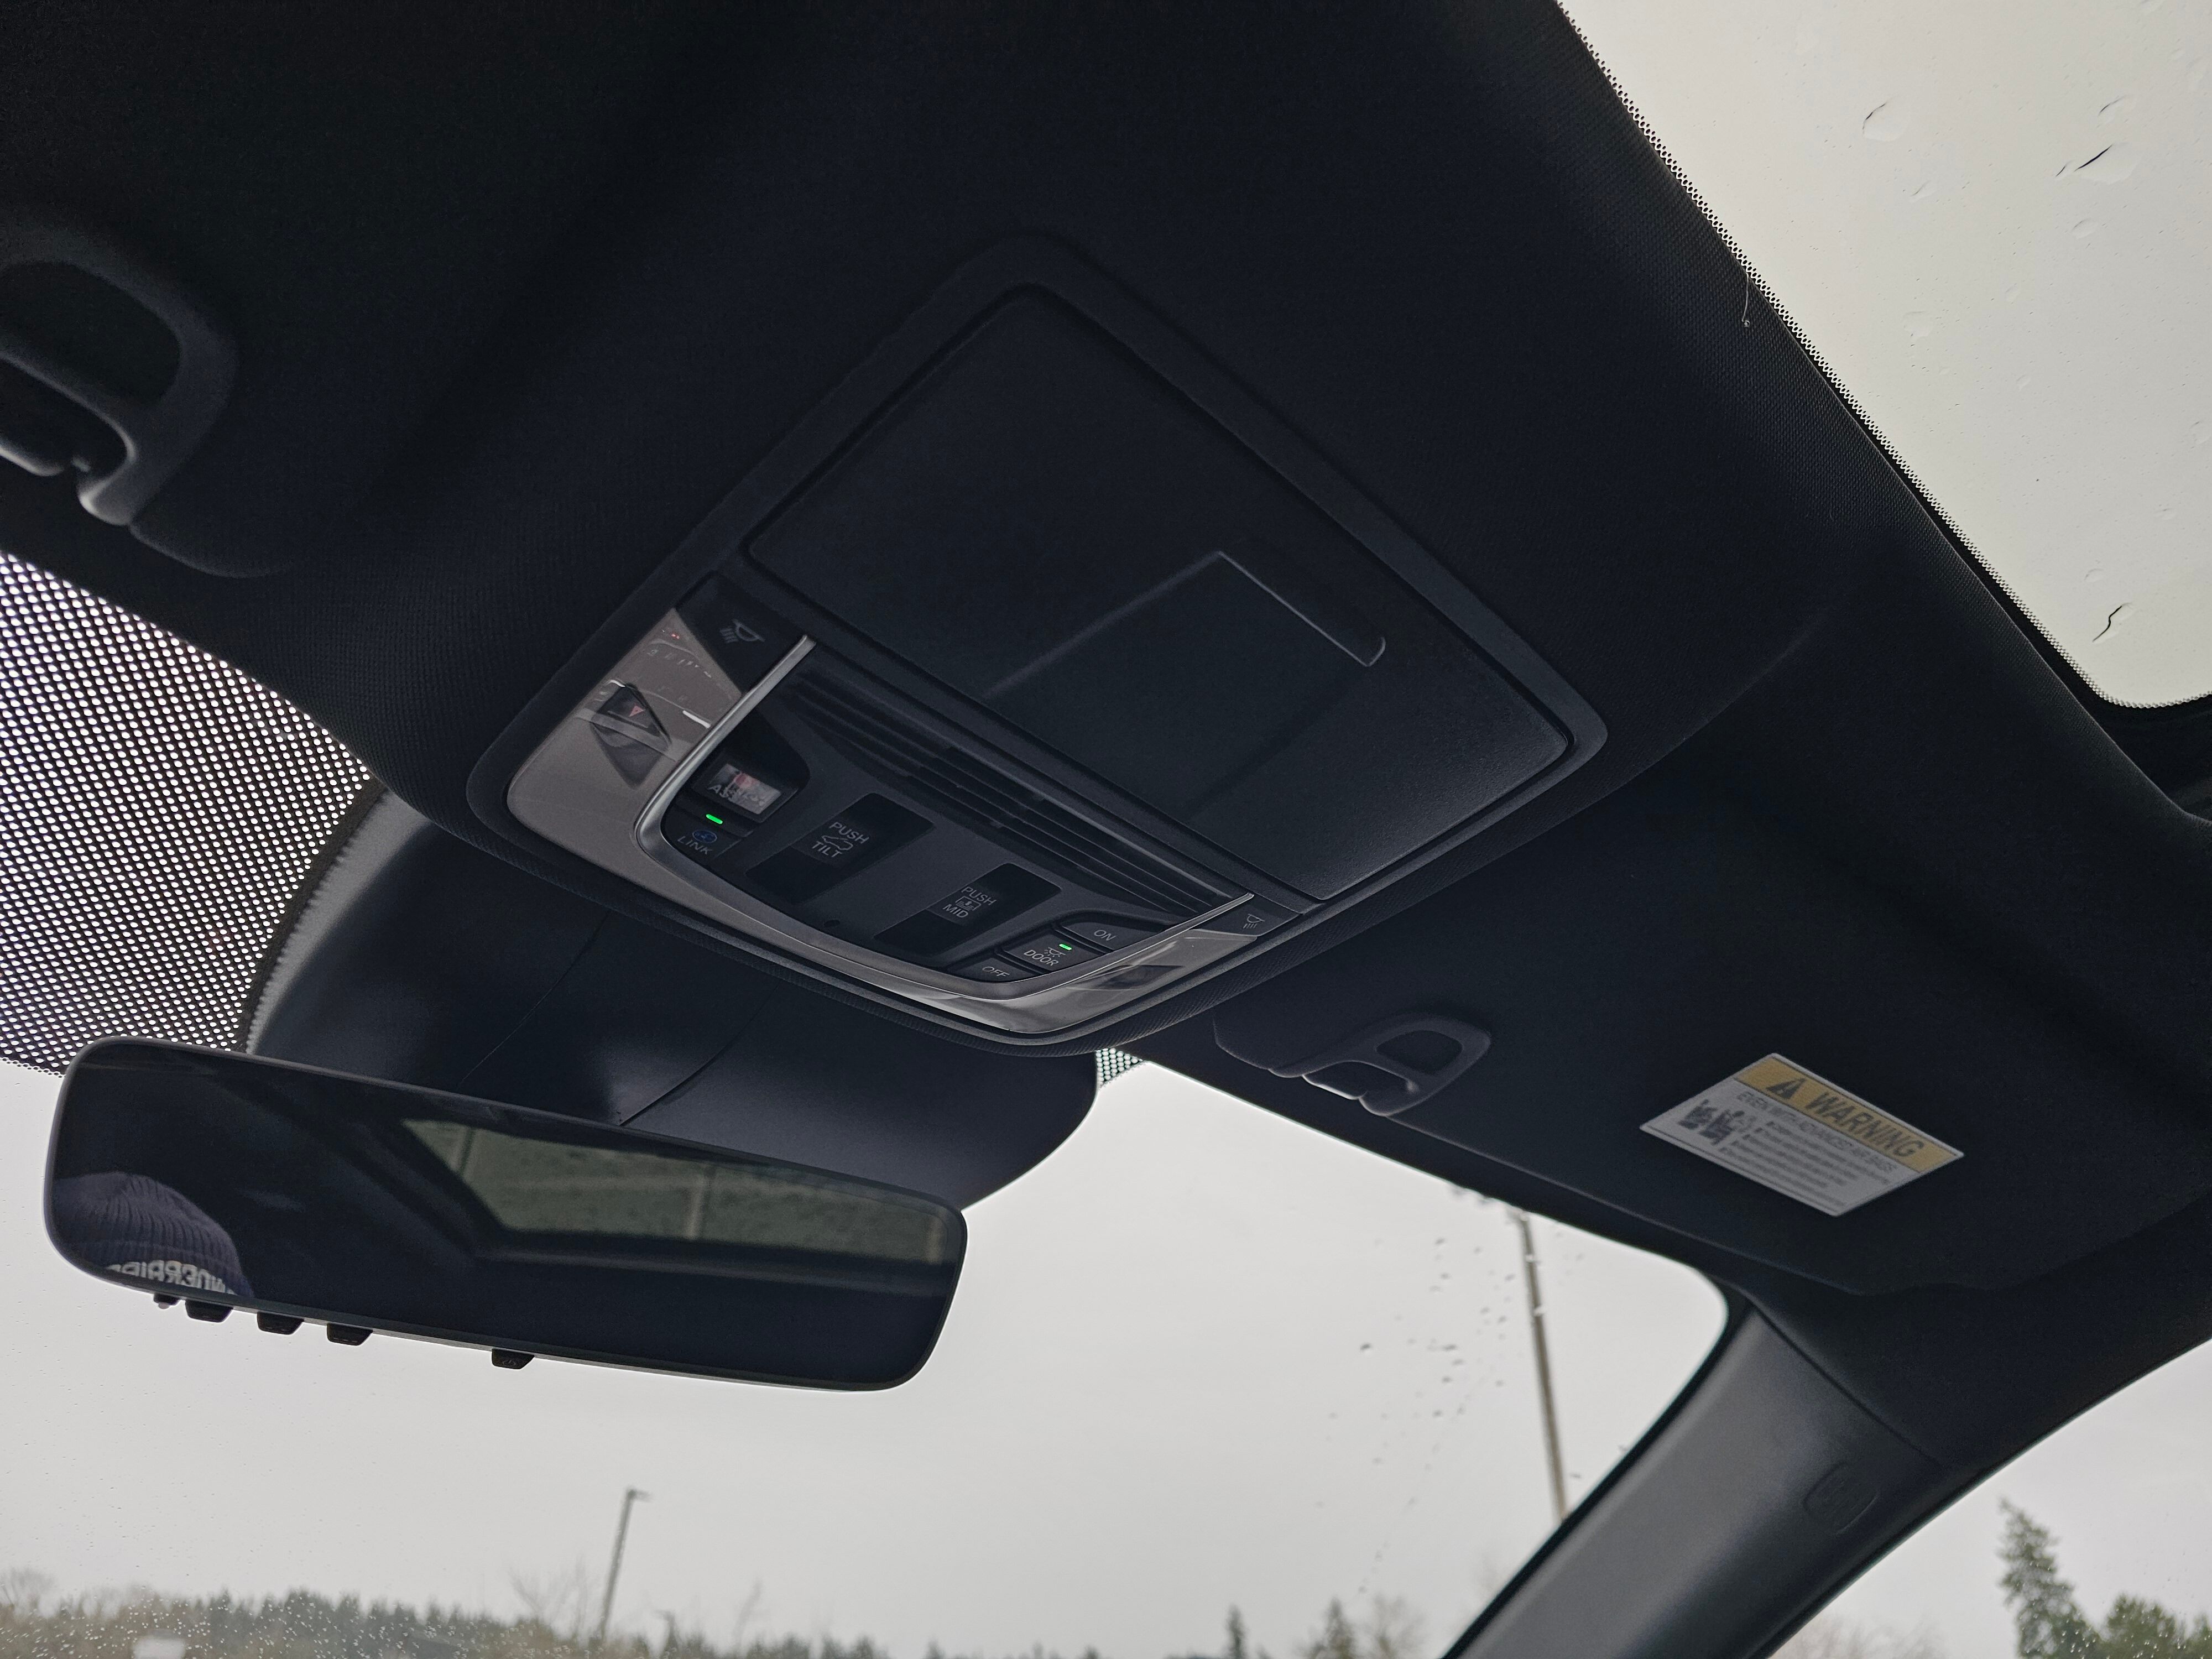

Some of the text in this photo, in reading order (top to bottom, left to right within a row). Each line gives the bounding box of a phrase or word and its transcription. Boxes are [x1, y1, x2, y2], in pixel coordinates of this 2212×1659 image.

[829, 822, 869, 844] PUSH
[677, 836, 713, 854] LINK
[812, 841, 842, 858] TILT
[961, 886, 998, 905] PUSH
[942, 904, 969, 918] MID
[1093, 930, 1117, 941] ON
[1024, 949, 1059, 966] DOOR
[982, 966, 1010, 977] OFF
[1804, 1092, 1925, 1157] WARNING
